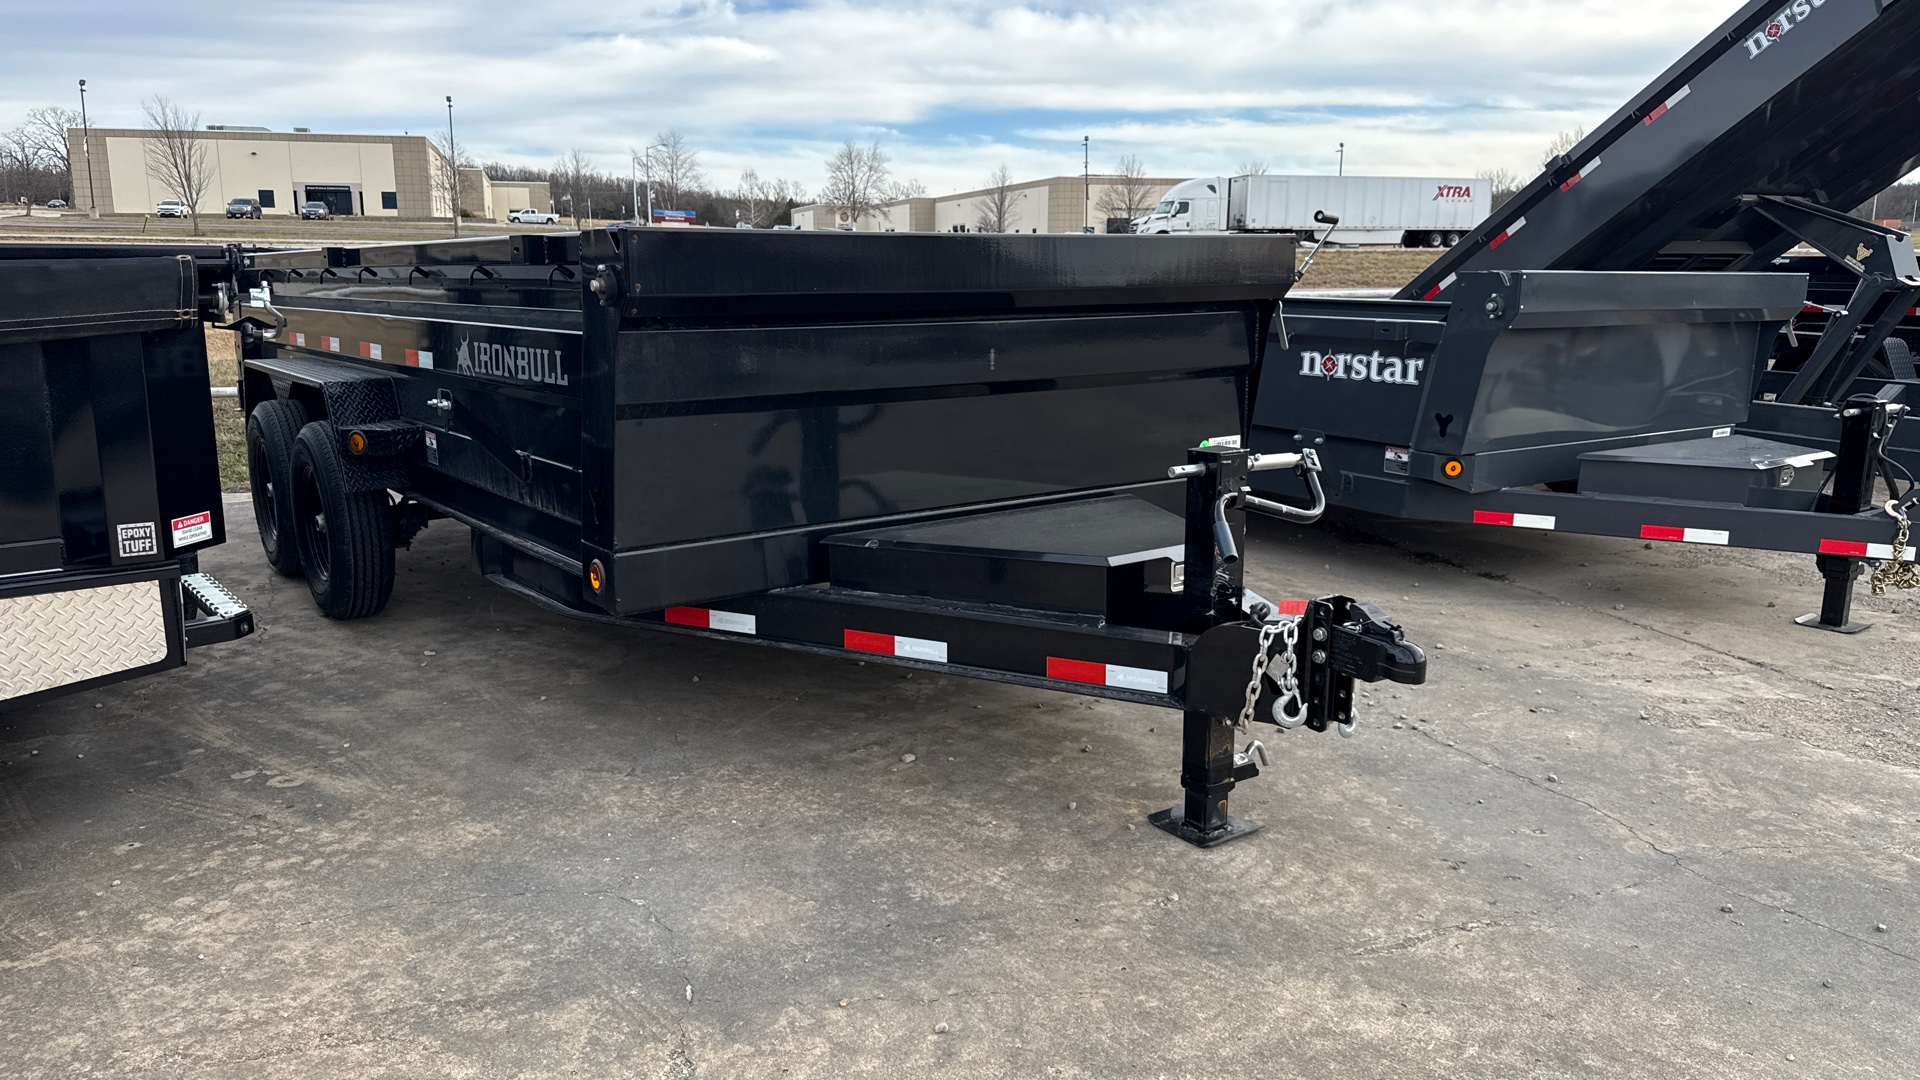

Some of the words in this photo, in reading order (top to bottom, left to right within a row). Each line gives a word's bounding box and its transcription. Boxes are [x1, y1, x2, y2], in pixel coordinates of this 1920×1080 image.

[1432, 185, 1471, 201] XTRA
[473, 341, 568, 386] IRONBULL
[1299, 350, 1424, 385] norstar
[183, 516, 204, 527] DANGER
[122, 527, 151, 539] EPOXY
[123, 539, 152, 553] TUFF
